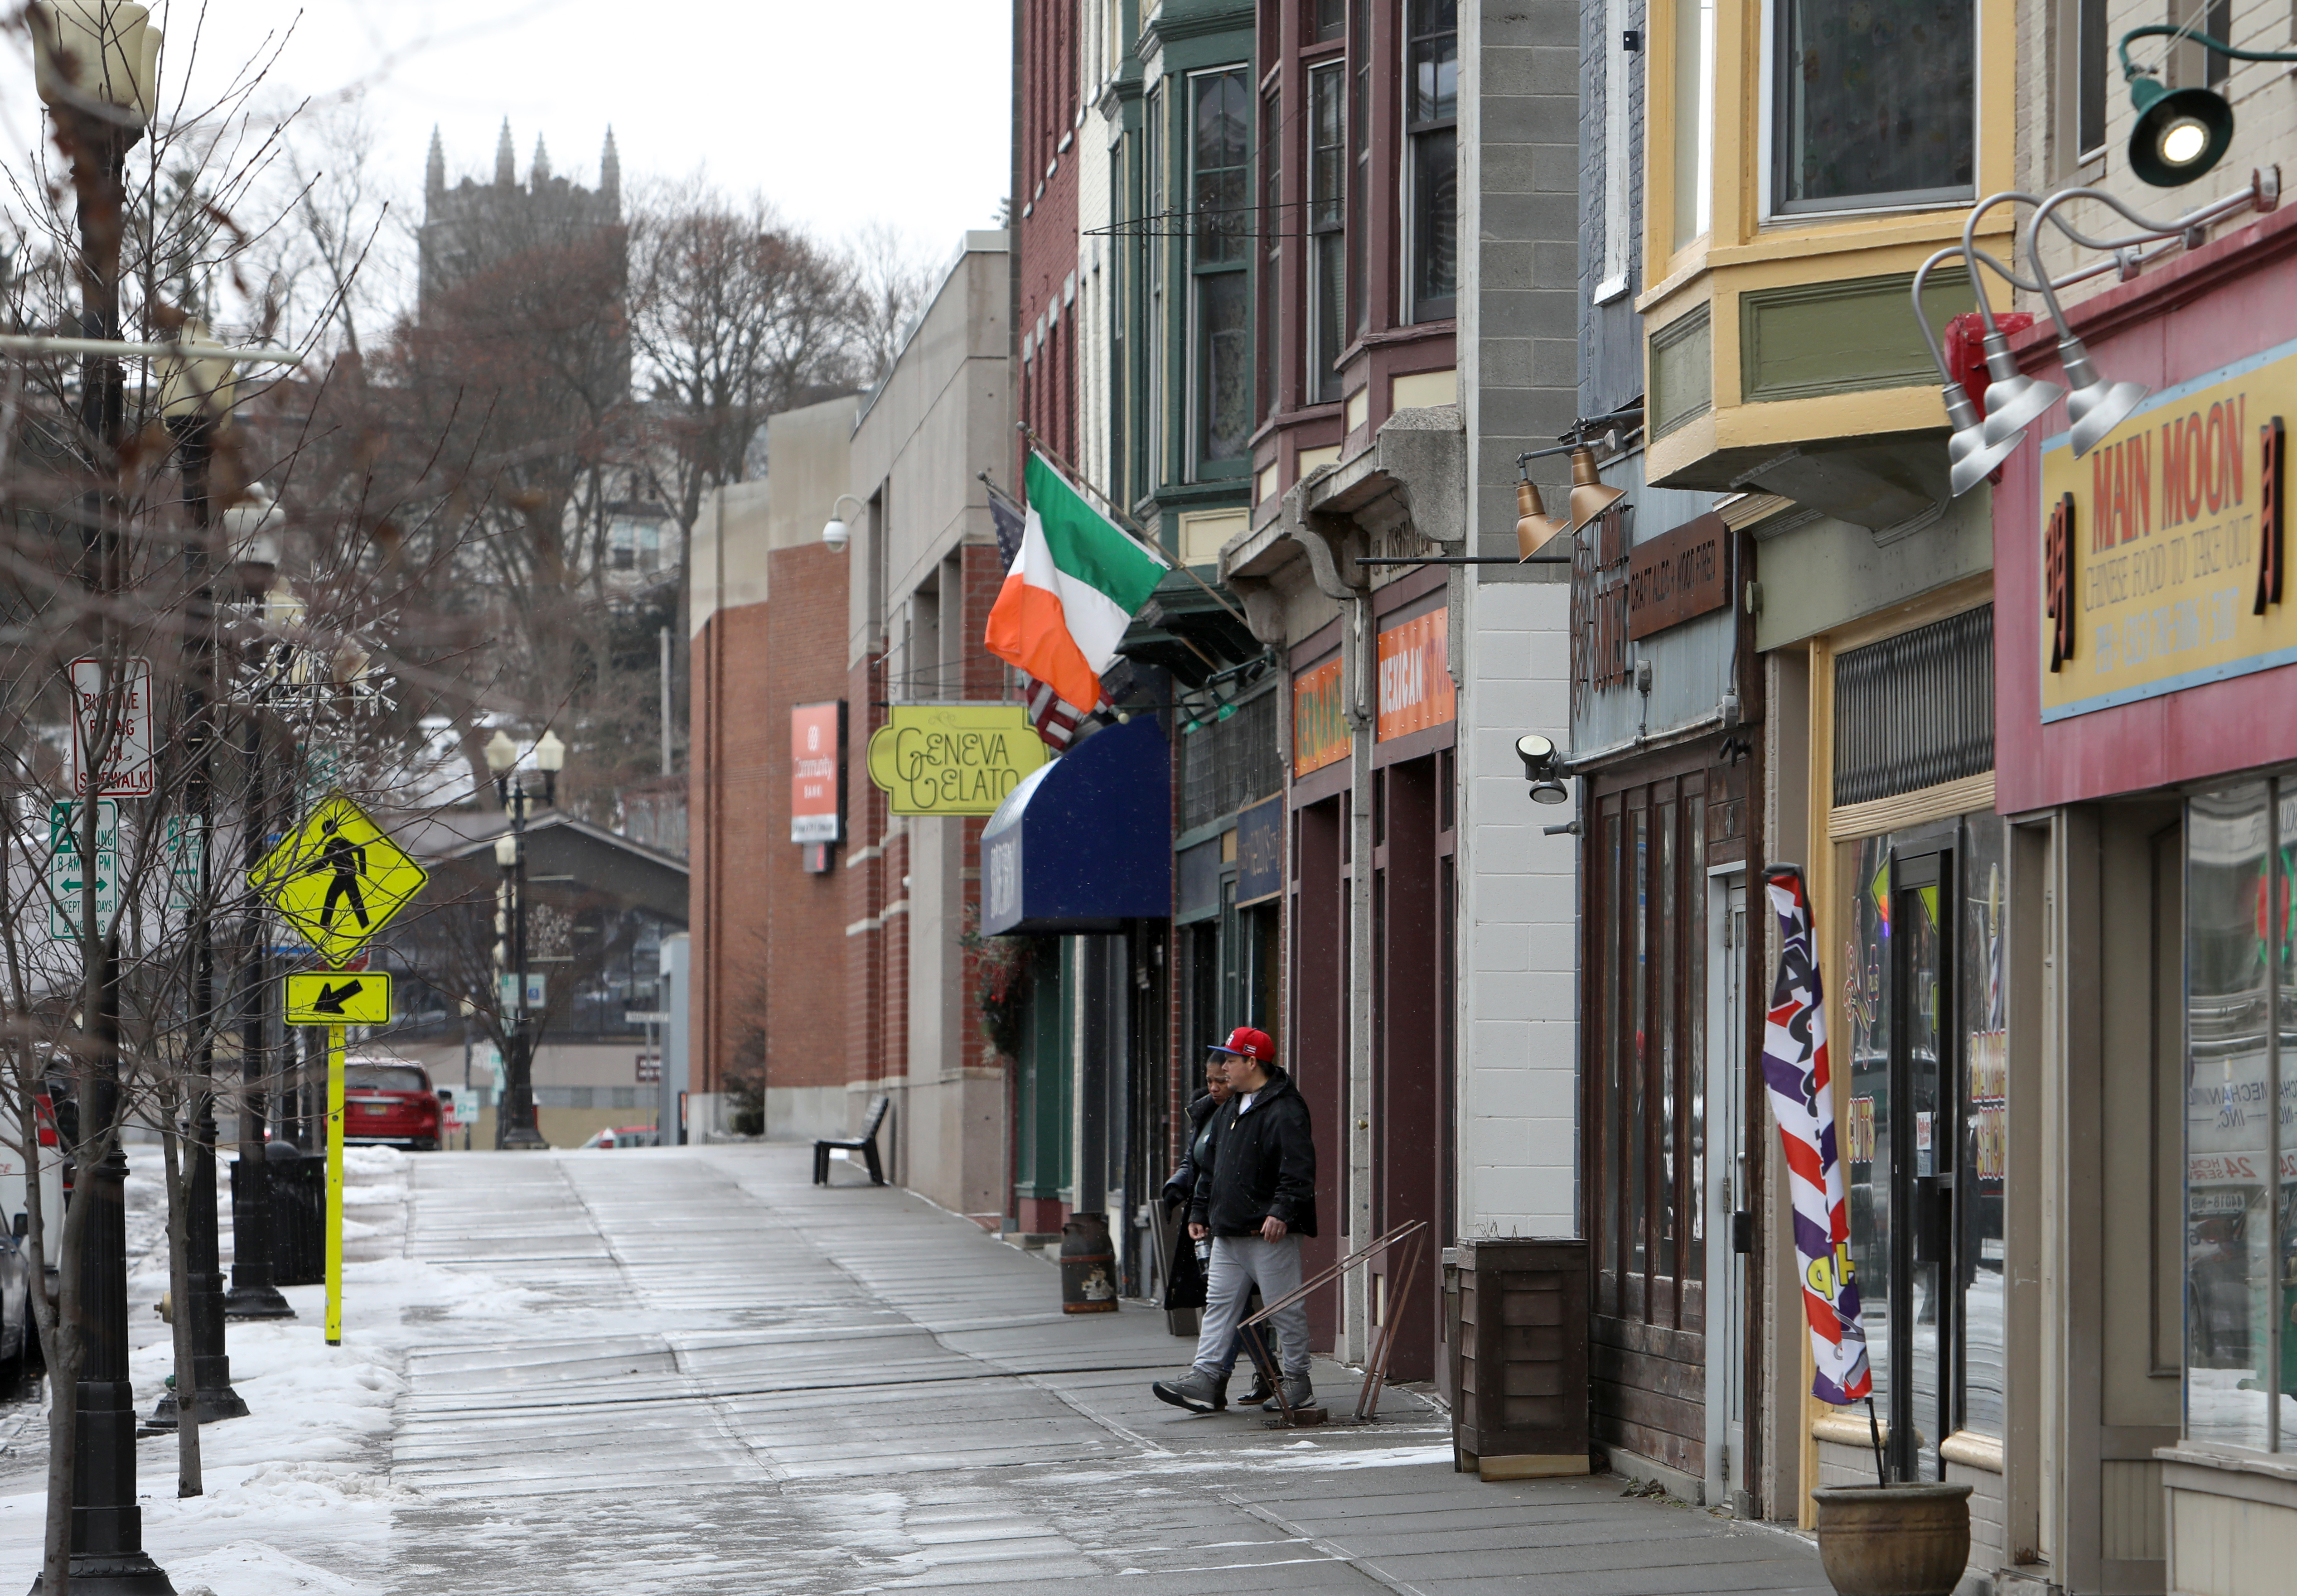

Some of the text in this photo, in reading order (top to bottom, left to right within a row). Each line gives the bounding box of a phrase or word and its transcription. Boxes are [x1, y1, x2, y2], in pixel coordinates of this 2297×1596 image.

[2092, 392, 2246, 555] MAIN MOON
[1631, 566, 1652, 612] CRAFT
[1653, 559, 1670, 603] ALES
[1677, 548, 1695, 593] WOOD
[1696, 539, 1716, 585] FIRED
[2084, 514, 2254, 613] CHINESE FOOD TO TAKE OUT
[1380, 635, 1451, 718] MEXICAN STOR
[1297, 674, 1352, 760] HERNAND
[896, 727, 1010, 782] GENEVA
[910, 754, 1020, 809] GELATO
[803, 784, 822, 799] BANK
[57, 854, 111, 873] 8 AM PM
[1846, 1095, 1876, 1164] CUTS
